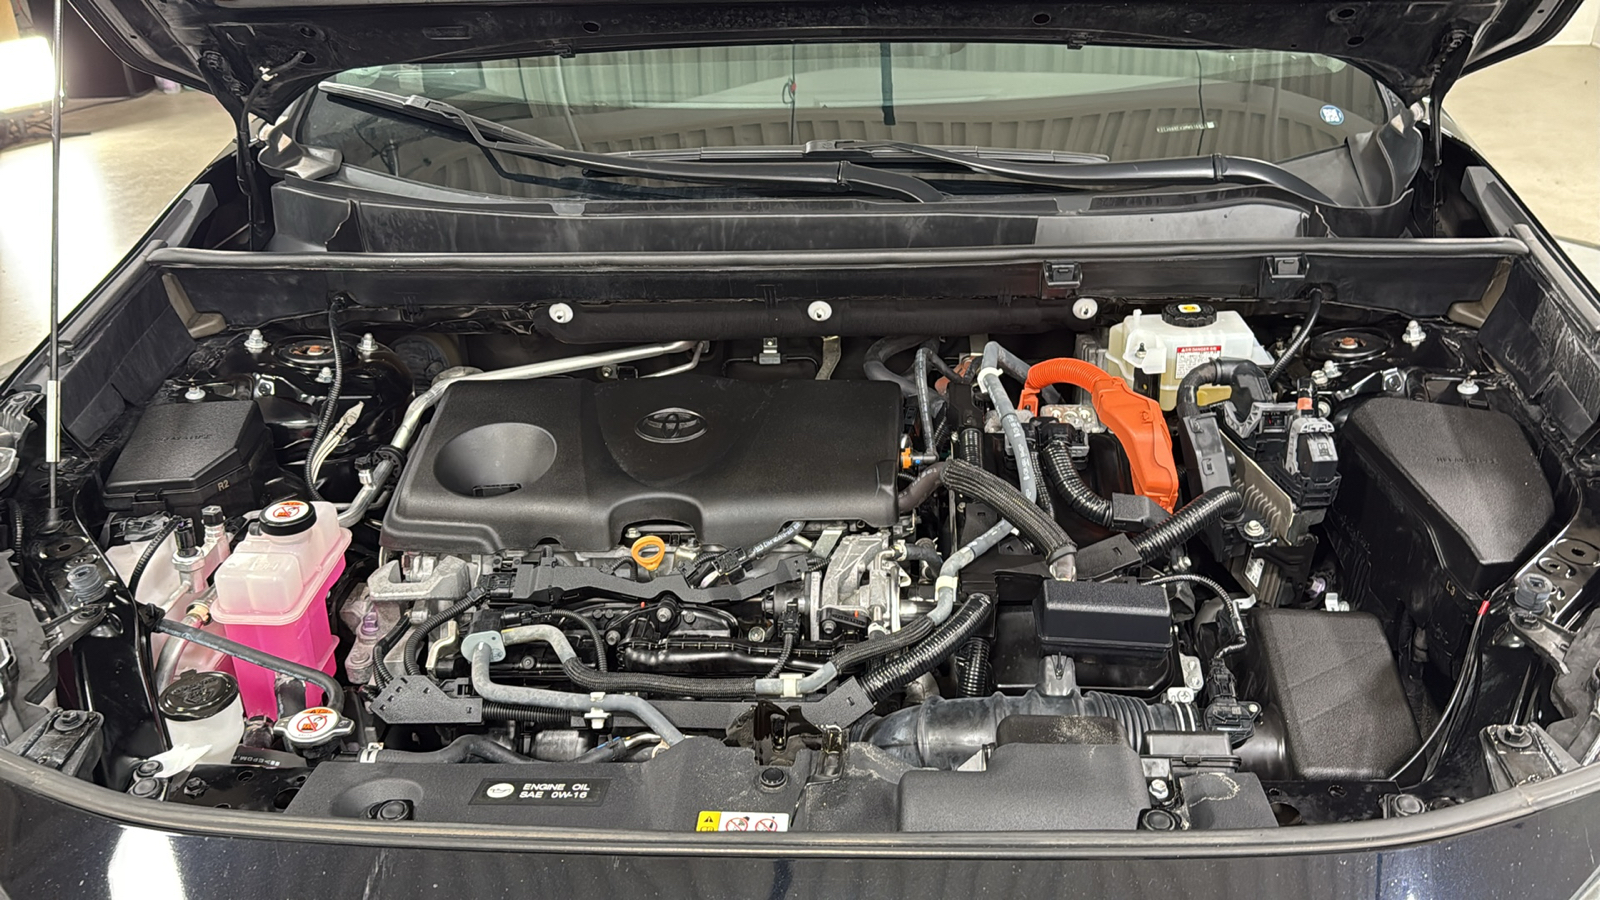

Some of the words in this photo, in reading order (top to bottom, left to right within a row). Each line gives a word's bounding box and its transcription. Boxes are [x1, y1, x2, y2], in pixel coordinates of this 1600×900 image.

[217, 479, 230, 492] R2
[1445, 580, 1456, 596] L3
[522, 783, 565, 791] ENGINE
[572, 783, 590, 791] OIL
[519, 791, 543, 799] SAE
